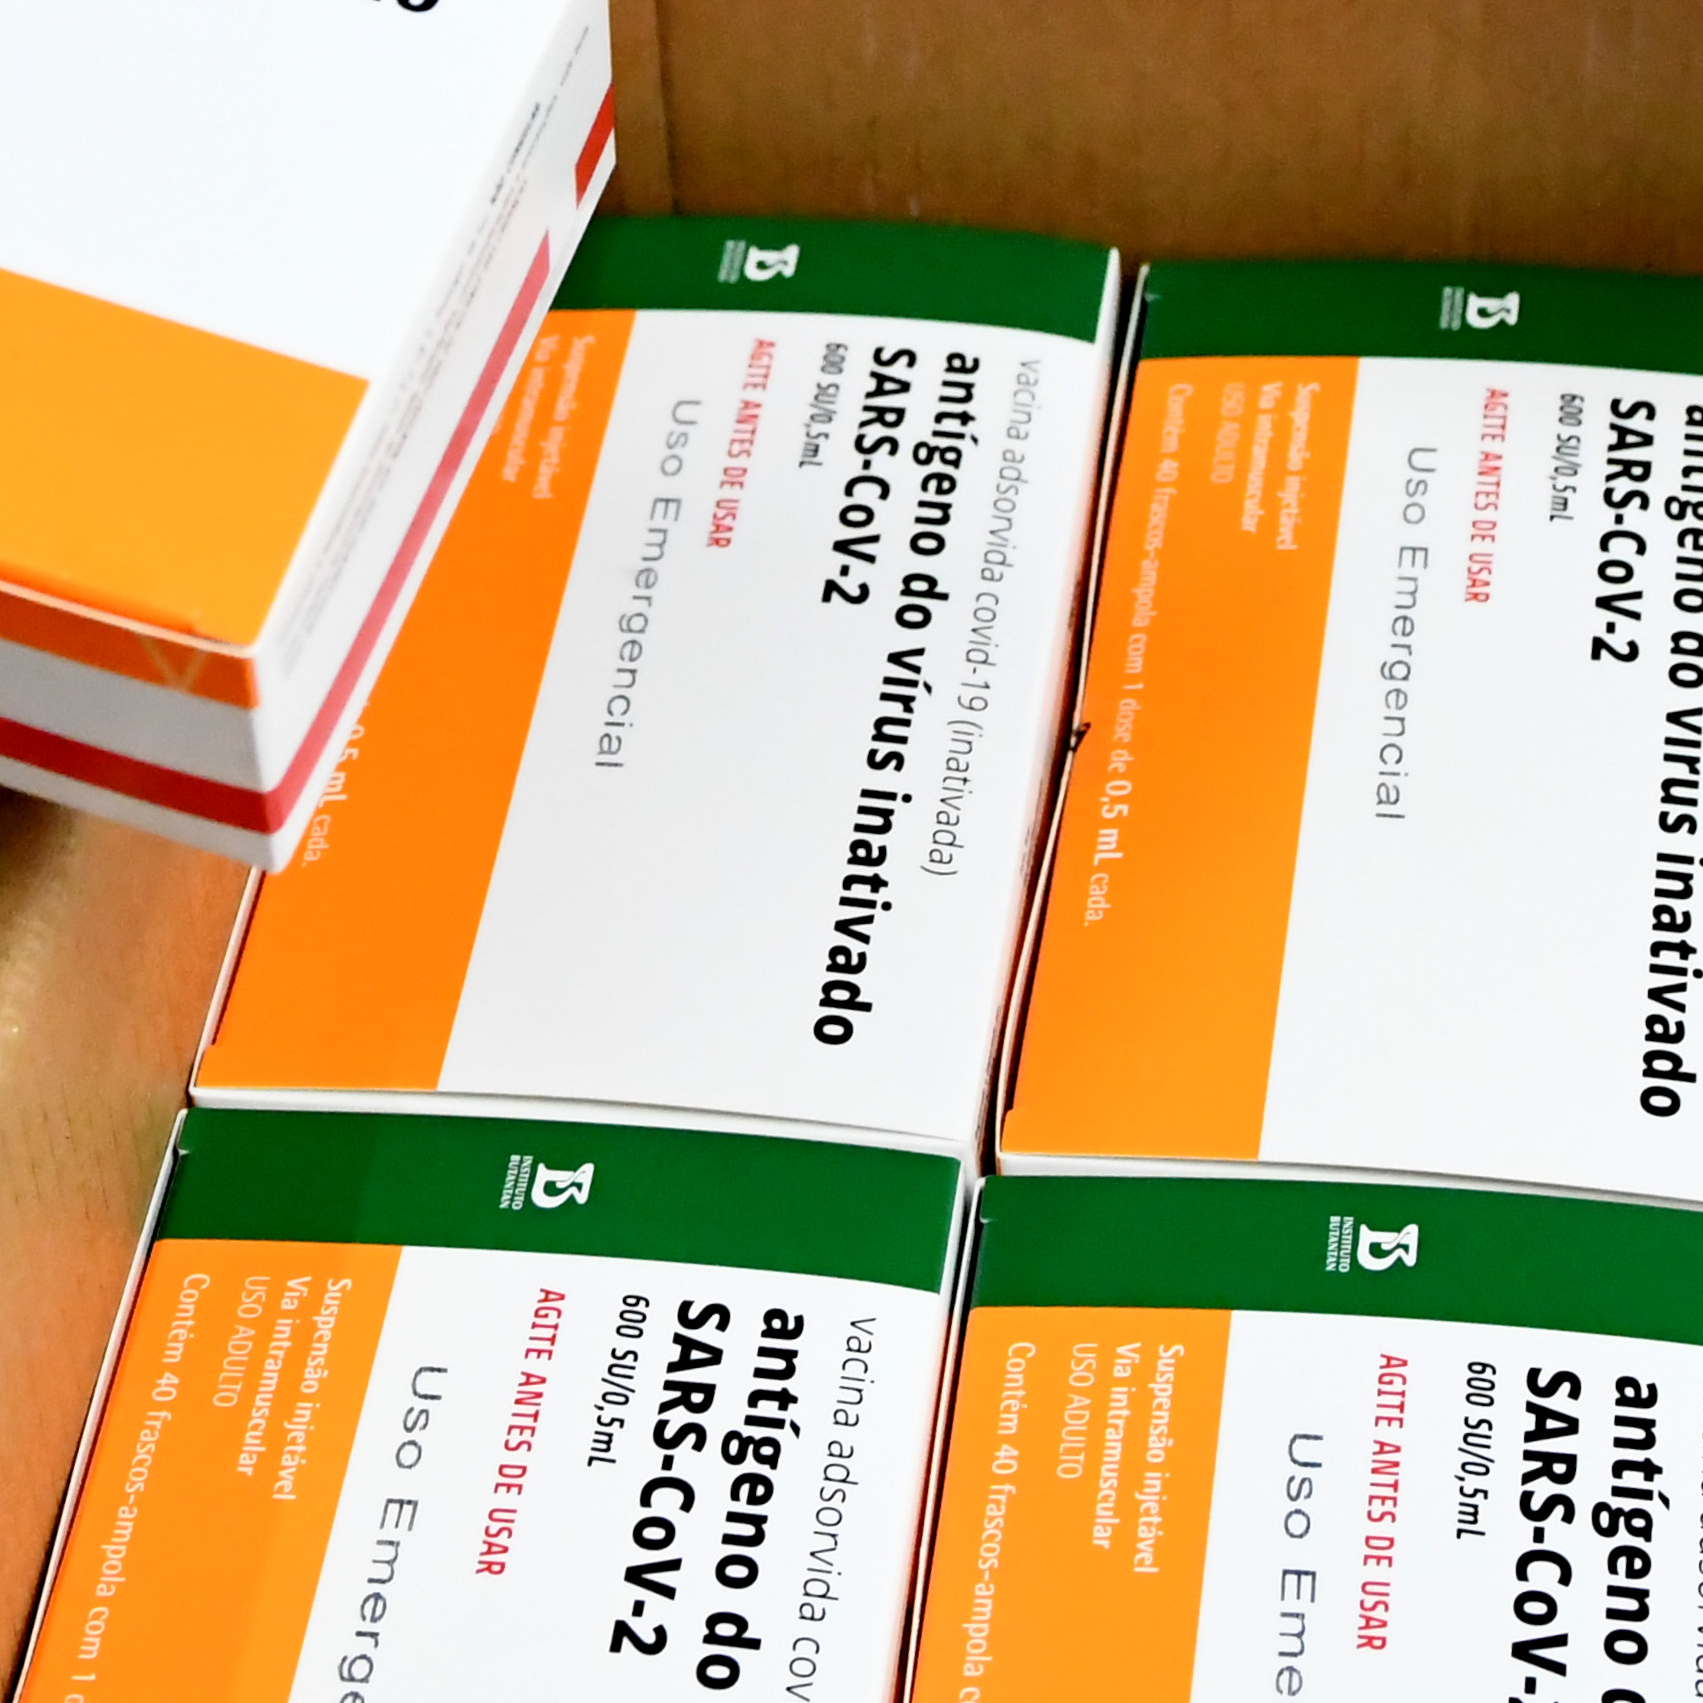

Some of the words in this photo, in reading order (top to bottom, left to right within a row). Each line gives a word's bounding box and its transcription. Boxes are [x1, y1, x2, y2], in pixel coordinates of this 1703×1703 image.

[659, 399, 703, 478] Uso
[821, 346, 918, 605] SARS-CoV-2
[909, 351, 981, 557] antígeno
[1401, 446, 1438, 526] Uso
[1590, 397, 1657, 663] SARS-CoV-2
[594, 496, 683, 768] Emergencial
[894, 572, 950, 630] do
[866, 647, 933, 773] vírus
[1374, 545, 1429, 820] Emergencial
[812, 788, 913, 1046] inativado
[161, 1273, 211, 1364] Contém
[236, 1275, 272, 1320] USO
[280, 1276, 313, 1311] Via
[300, 1277, 353, 1395] Suspensão
[524, 1288, 566, 1361] AGITE
[615, 1294, 650, 1339] 600
[151, 1371, 180, 1403] 40
[212, 1324, 256, 1408] ADULTO
[236, 1318, 301, 1477] intramuscular
[586, 1347, 639, 1468] SU/0,5mL
[832, 1317, 877, 1428] vacina
[1068, 1342, 1098, 1388] USO
[1112, 1342, 1142, 1378] Via
[1145, 1344, 1186, 1464] Suspensão
[1374, 1353, 1409, 1429] AGITE
[1465, 1361, 1497, 1408] 600
[272, 1402, 321, 1501] injetável
[394, 1365, 449, 1470] Uso
[503, 1371, 547, 1453] ANTES
[714, 1308, 805, 1590] antígeno
[1056, 1394, 1092, 1480] ADULTO
[94, 1409, 173, 1598] frascos-ampola
[493, 1463, 528, 1496] DE
[609, 1299, 731, 1656] SARS-CoV-2
[1092, 1386, 1137, 1551] intramuscular
[1283, 1433, 1324, 1540] Uso
[1366, 1439, 1402, 1524] ANTES
[1453, 1415, 1495, 1540] SU/0,5mL
[475, 1507, 518, 1576] USAR
[798, 1440, 859, 1623] adsorvida
[1133, 1471, 1170, 1574] injetável
[1362, 1535, 1395, 1569] DE
[1499, 1367, 1582, 1703] SARS-CoV-
[1591, 1375, 1671, 1666] antígeno
[77, 1606, 110, 1660] com
[682, 1611, 762, 1702] do
[1355, 1580, 1391, 1651] USAR
